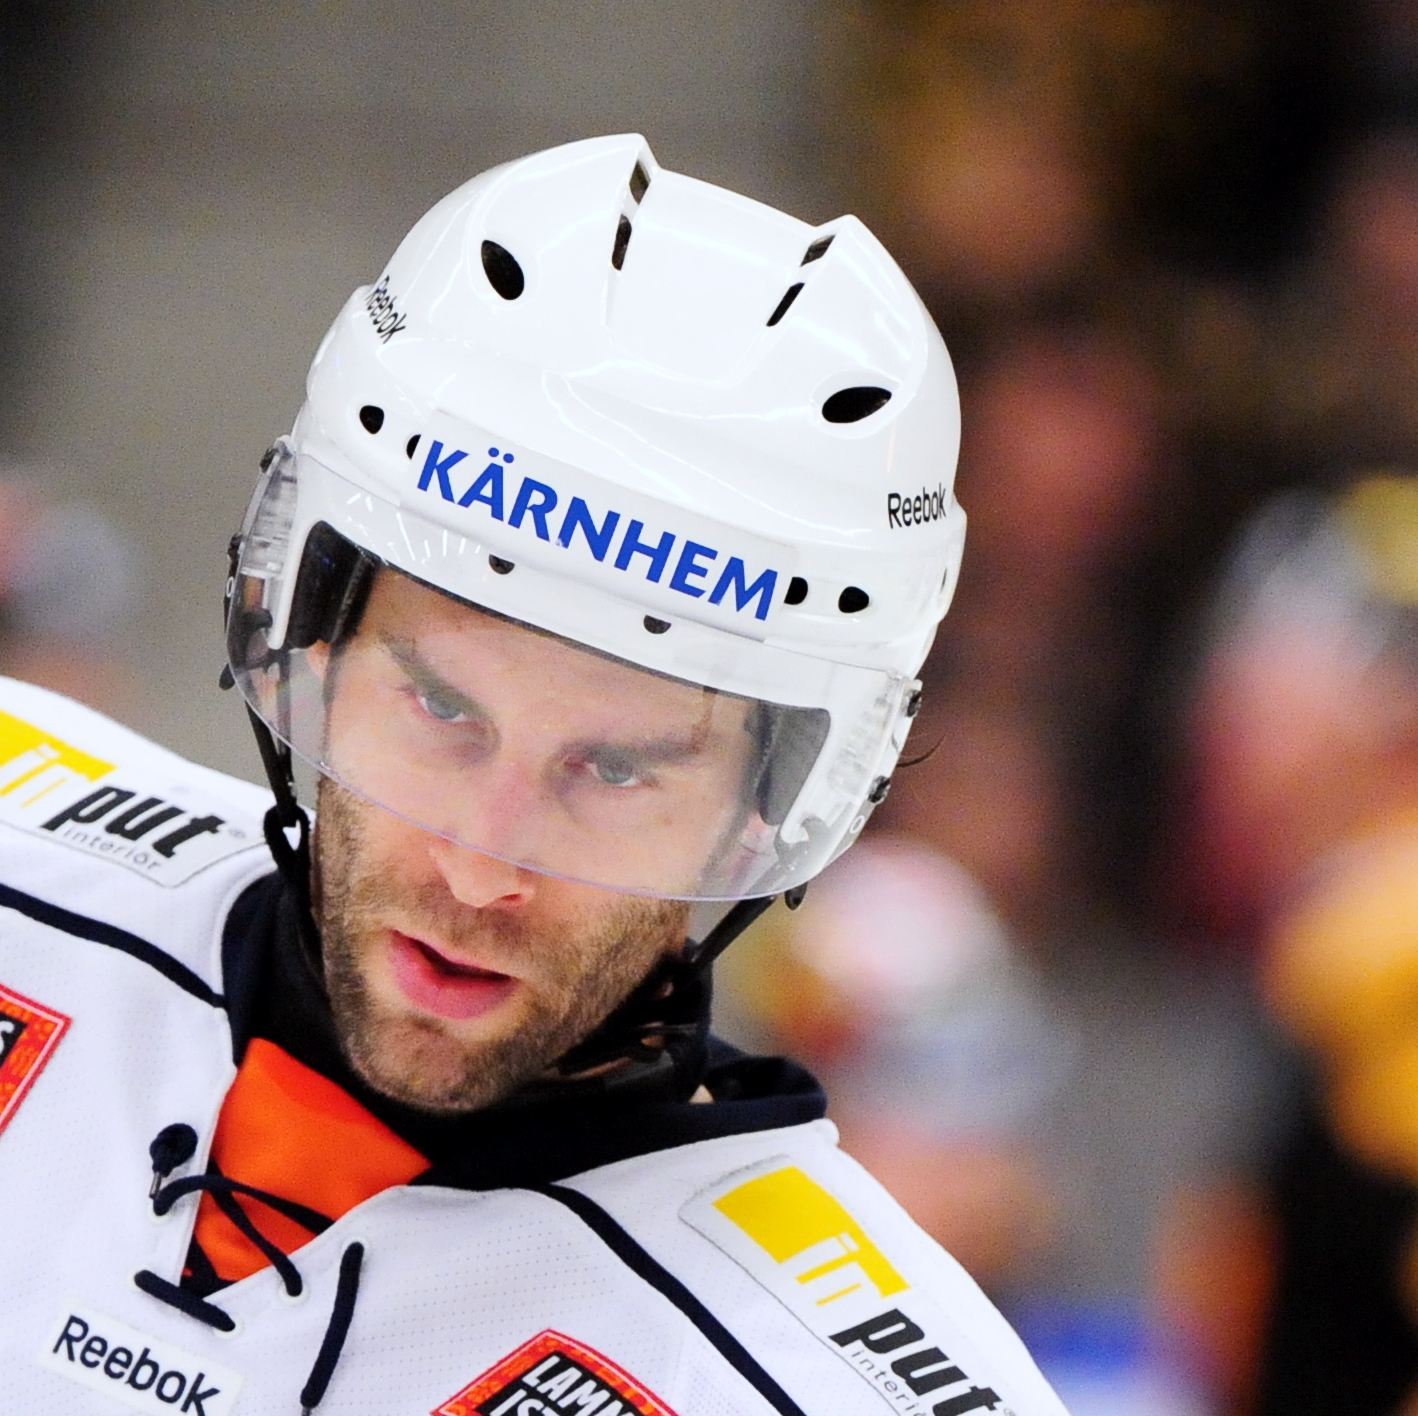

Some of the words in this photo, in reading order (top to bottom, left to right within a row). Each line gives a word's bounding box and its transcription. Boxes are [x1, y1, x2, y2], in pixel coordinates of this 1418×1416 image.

[365, 274, 407, 345] Reebok
[416, 439, 780, 621] KÄRNHEM
[887, 482, 947, 529] Reebok
